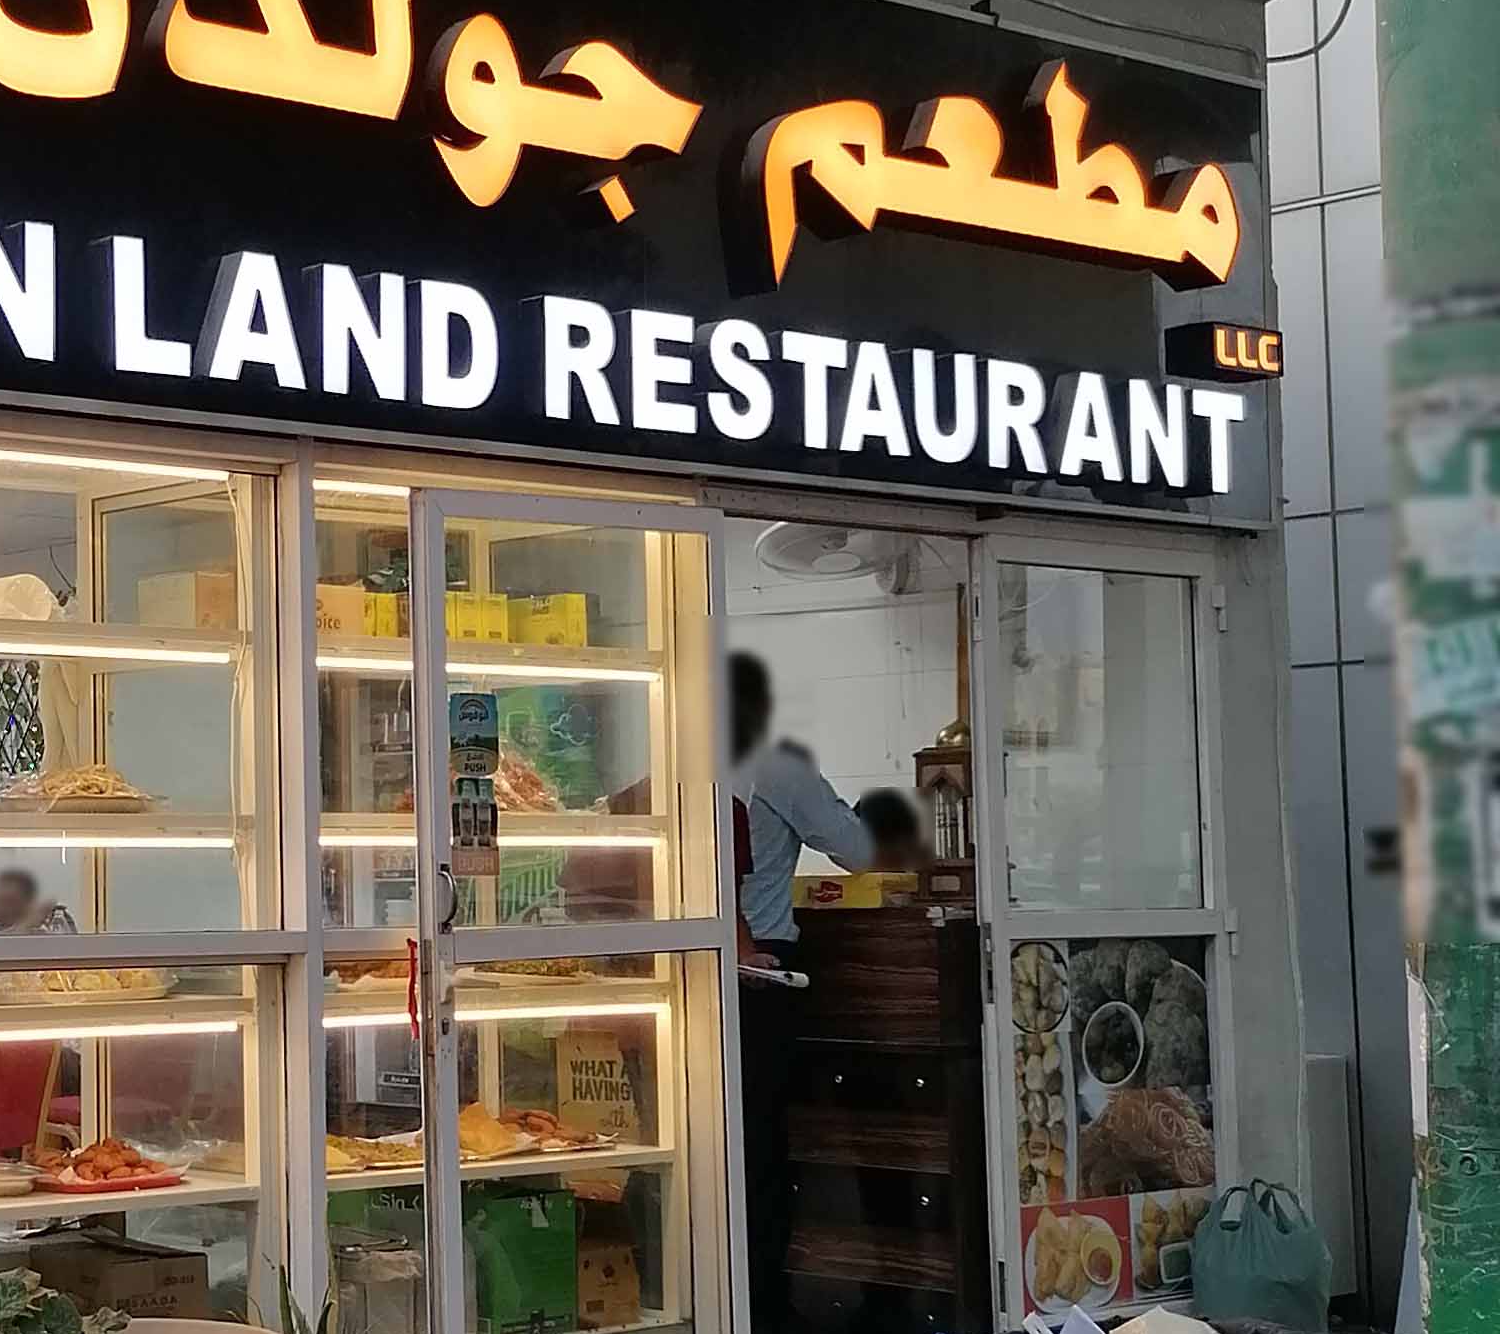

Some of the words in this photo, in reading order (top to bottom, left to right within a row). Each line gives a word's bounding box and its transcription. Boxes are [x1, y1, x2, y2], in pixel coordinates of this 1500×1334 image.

[764, 62, 1241, 284] مطعم
[112, 235, 499, 410] LAND
[543, 294, 1245, 494] RESTAURANT
[1215, 328, 1279, 372] LLC
[464, 762, 486, 773] PUSH
[570, 1060, 617, 1079] WHAT
[572, 1076, 630, 1102] HAVING
